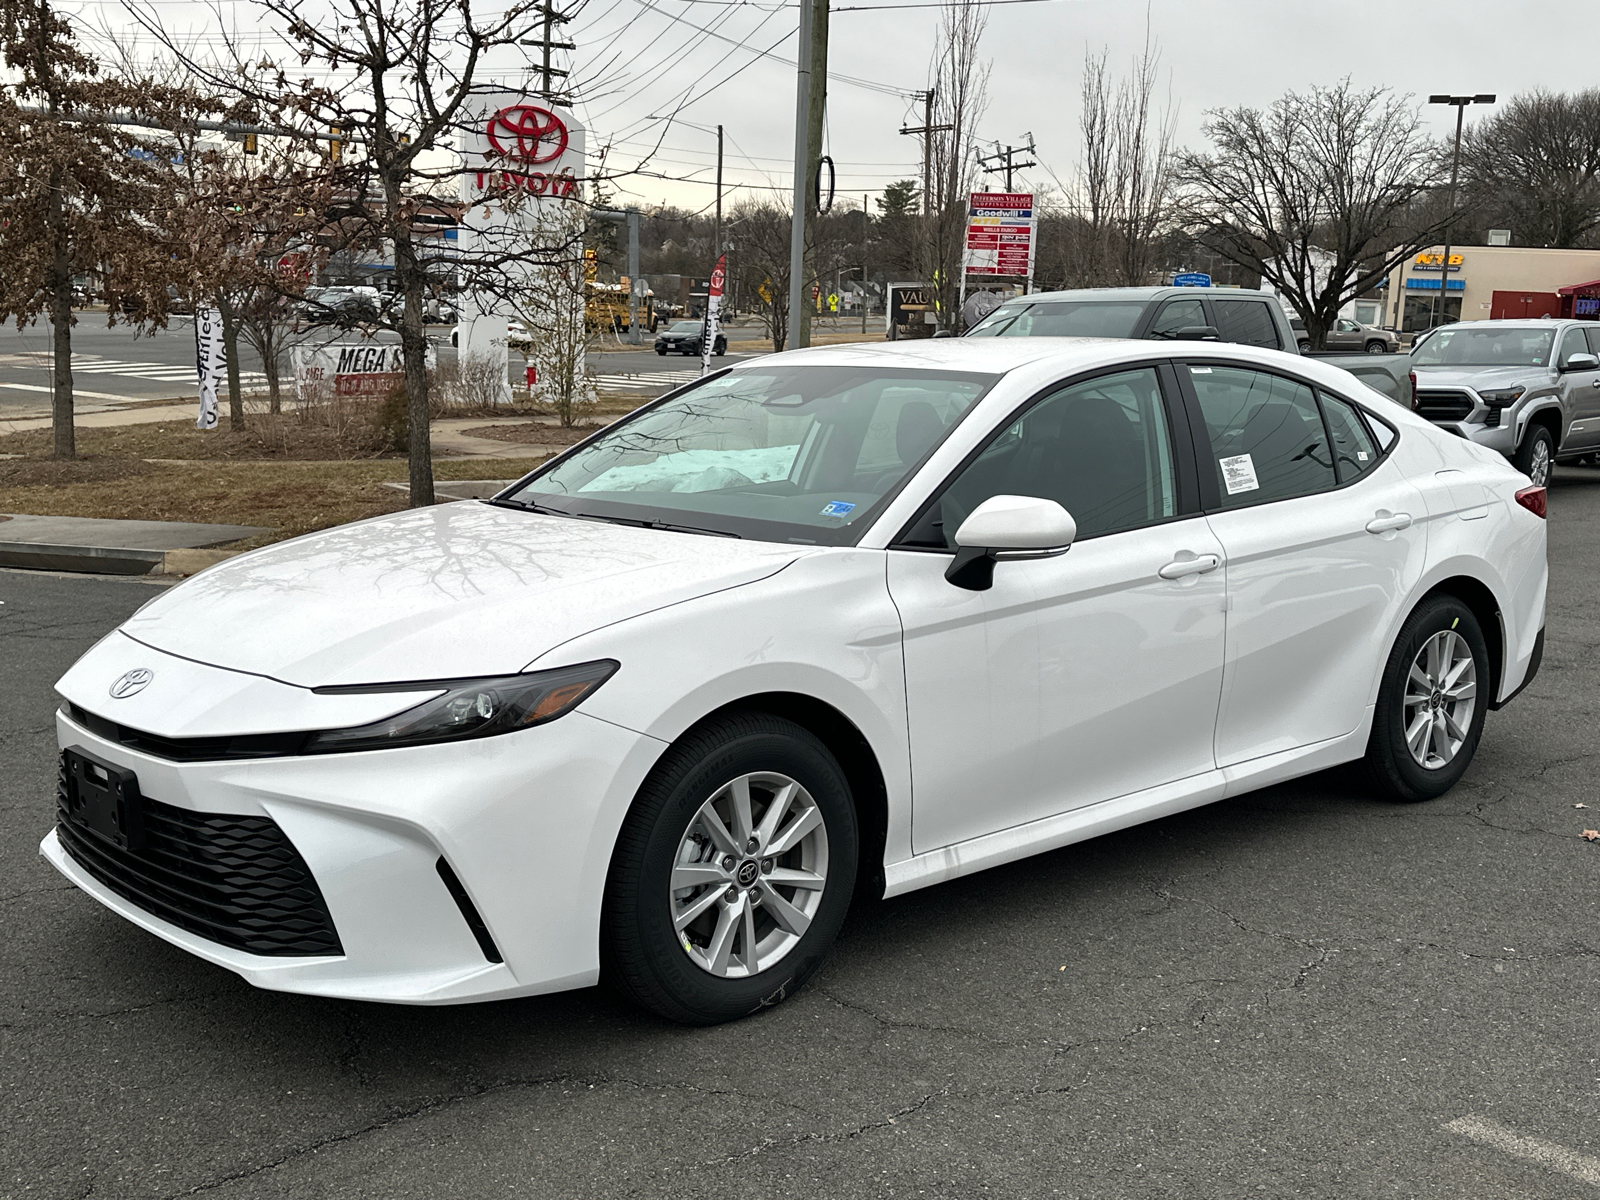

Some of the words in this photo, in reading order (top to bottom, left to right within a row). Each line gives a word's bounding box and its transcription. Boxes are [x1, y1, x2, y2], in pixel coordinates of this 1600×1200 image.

[1005, 195, 1032, 203] VILLAGE
[976, 209, 1018, 217] Goodwill
[1415, 254, 1464, 265] NTB
[899, 290, 931, 304] VAU
[336, 347, 388, 373] MEGA
[678, 753, 734, 811] RANGEMAX
